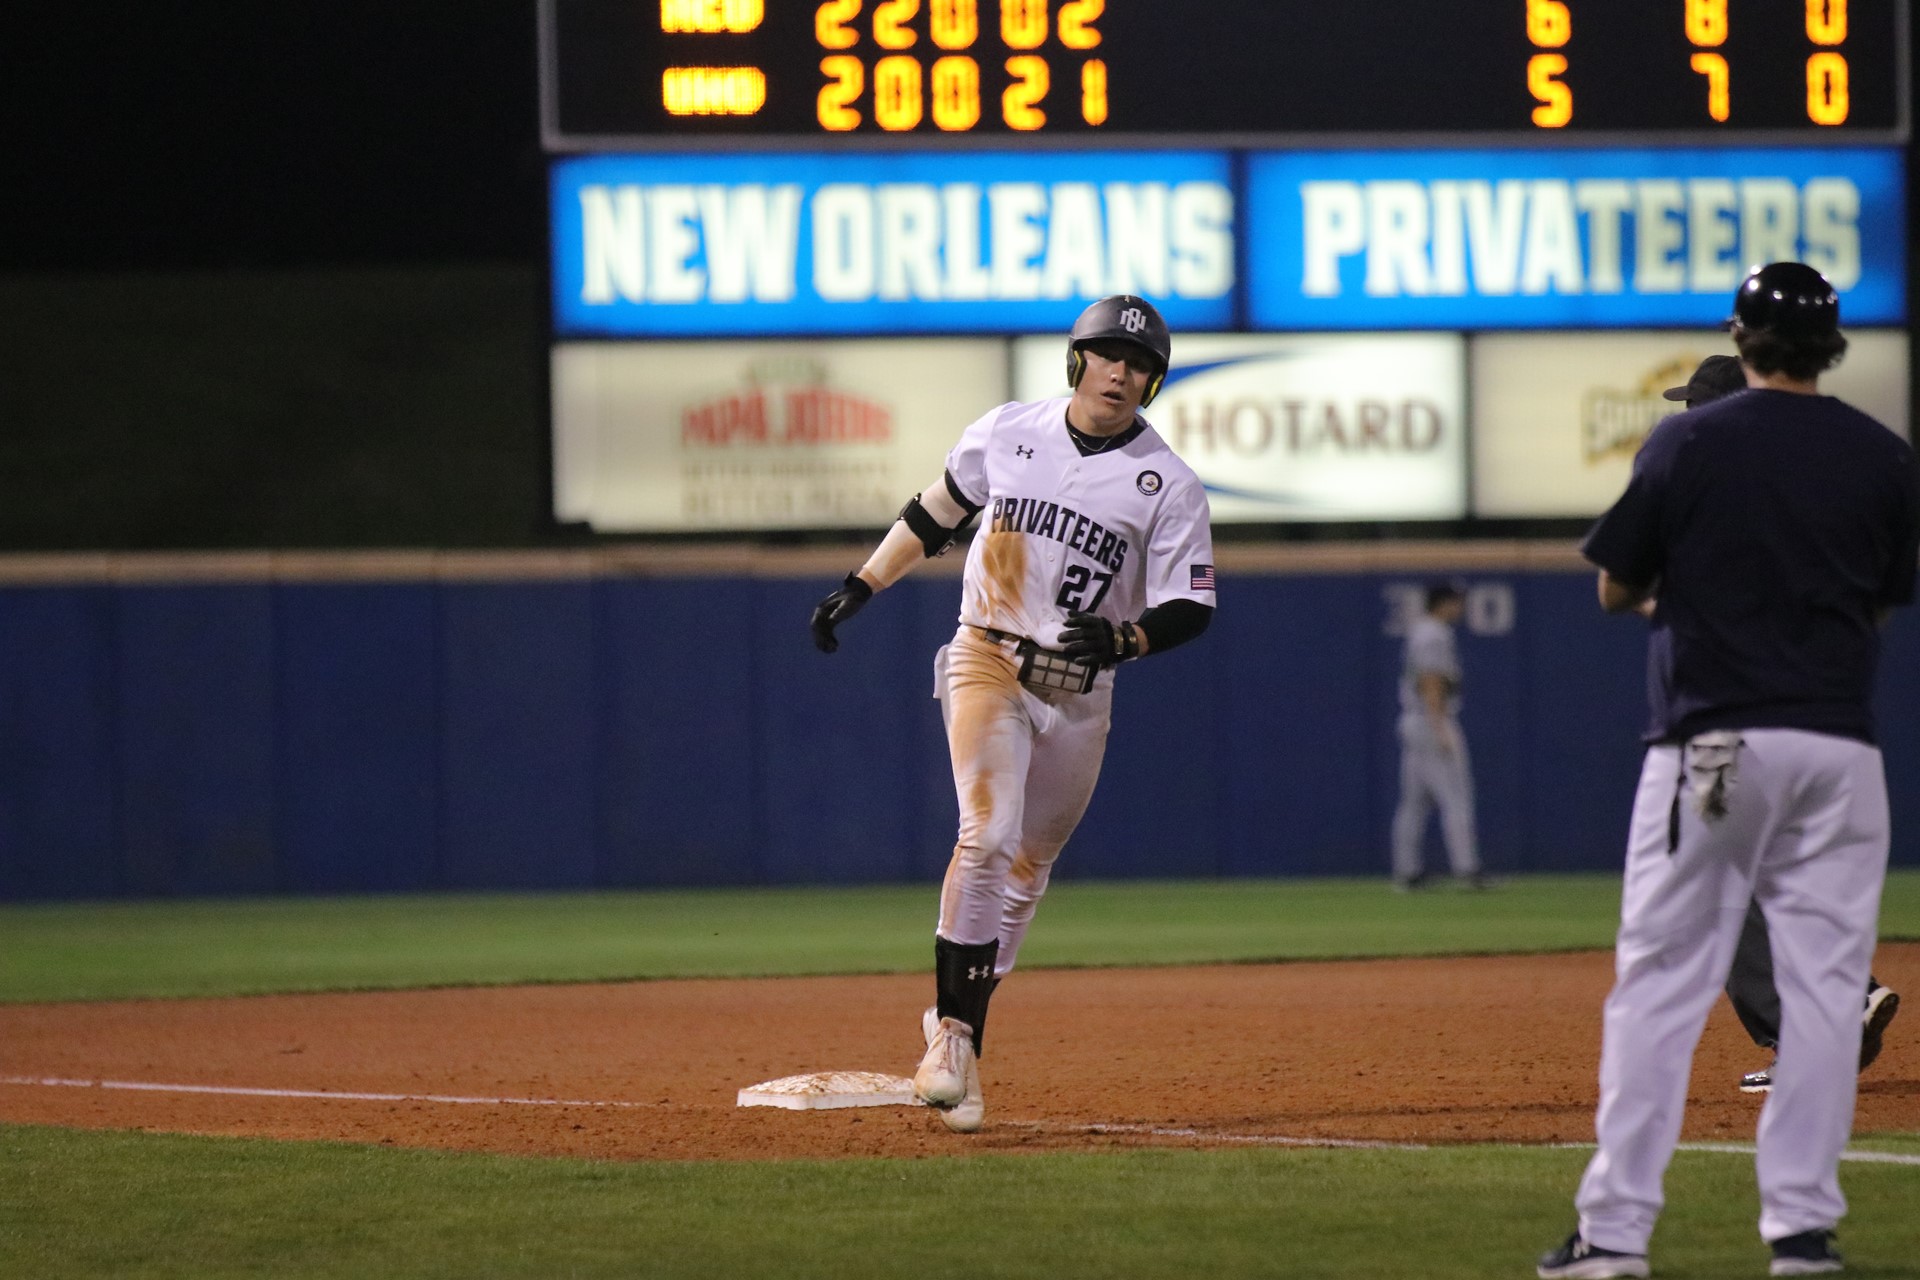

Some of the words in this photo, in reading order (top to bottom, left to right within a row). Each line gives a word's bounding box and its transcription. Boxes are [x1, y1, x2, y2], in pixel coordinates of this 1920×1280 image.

[1527, 53, 1573, 128] 5
[1690, 52, 1729, 122] 7
[1806, 52, 1849, 126] 0
[579, 185, 798, 304] NEW
[812, 181, 1234, 301] ORLEANS
[1302, 177, 1861, 297] PRIVATEERS
[1173, 398, 1442, 451] HOTARD
[991, 497, 1128, 574] PRIVATEERS
[1055, 564, 1113, 614] 27
[1381, 582, 1516, 636] 30
